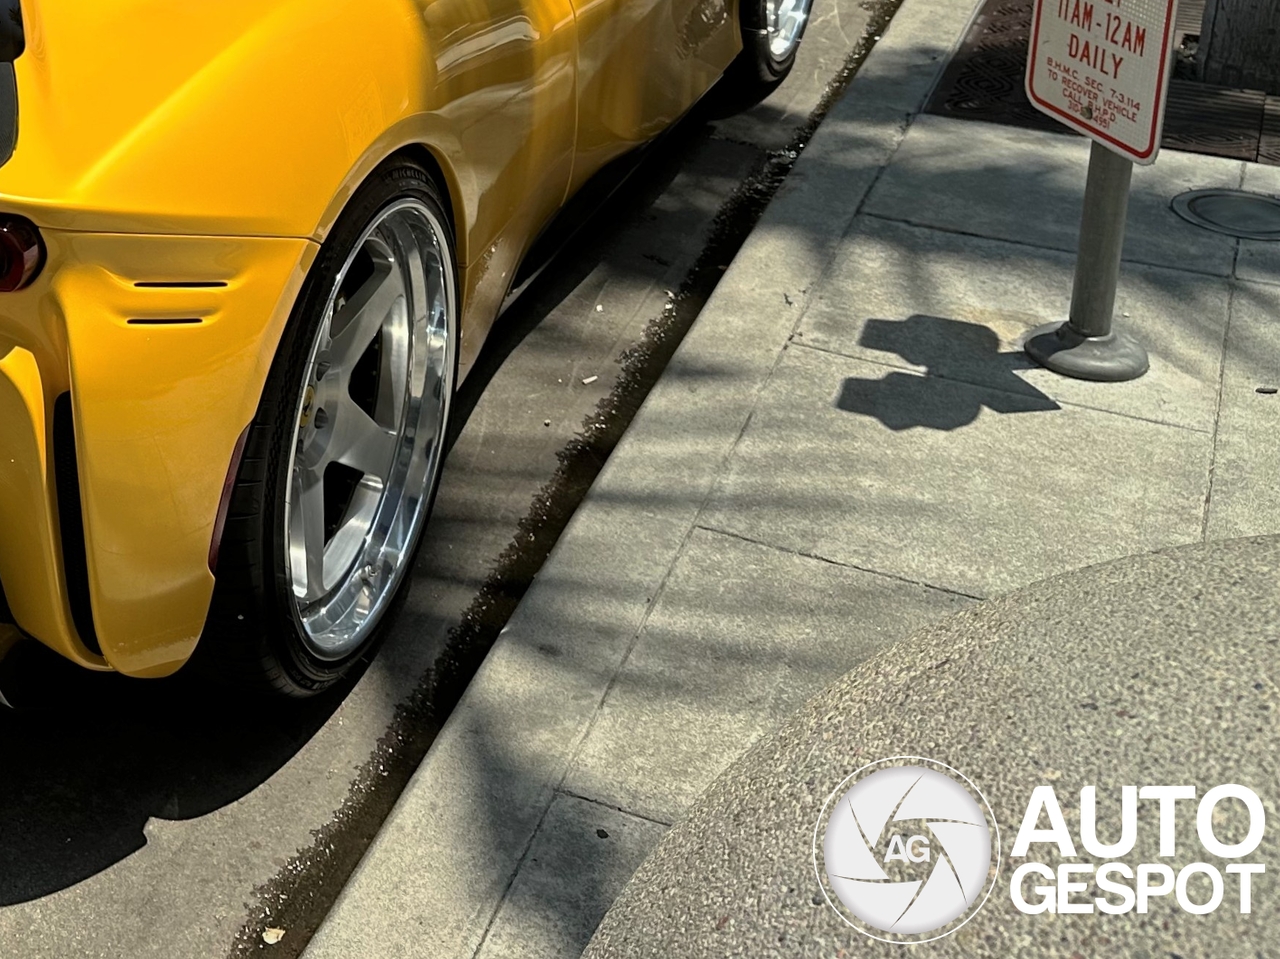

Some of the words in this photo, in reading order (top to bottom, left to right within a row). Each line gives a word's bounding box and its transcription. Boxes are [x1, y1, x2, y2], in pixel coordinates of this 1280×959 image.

[1068, 33, 1124, 80] DAILY
[1048, 68, 1058, 82] TO
[1061, 76, 1099, 102] RECOVER
[1103, 97, 1138, 123] VEHICLE
[1062, 87, 1083, 106] CALL
[392, 168, 427, 183] MICHELIN
